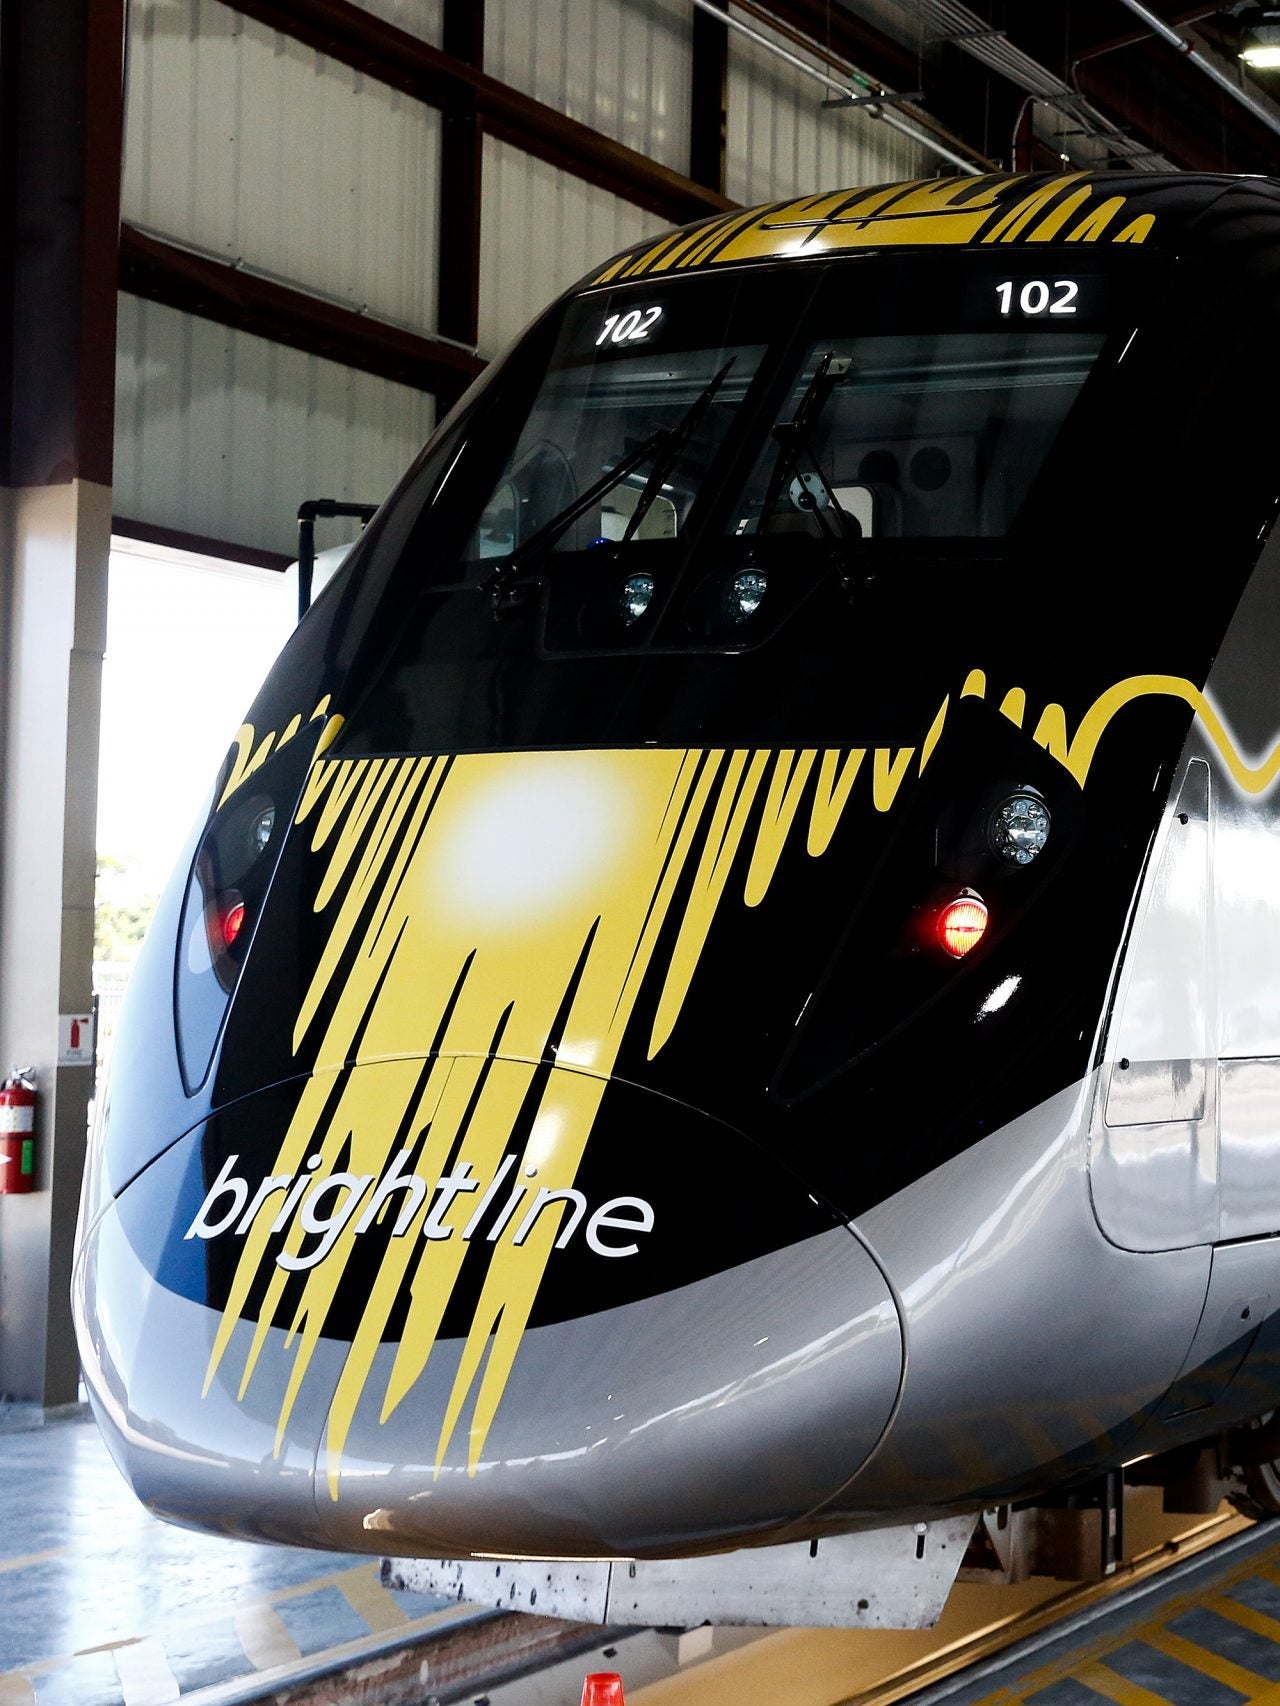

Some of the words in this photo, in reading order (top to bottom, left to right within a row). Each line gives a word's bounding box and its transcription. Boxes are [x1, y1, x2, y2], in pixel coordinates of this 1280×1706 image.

[996, 280, 1079, 314] 102
[595, 306, 663, 346] 102
[184, 1148, 655, 1271] brightline
